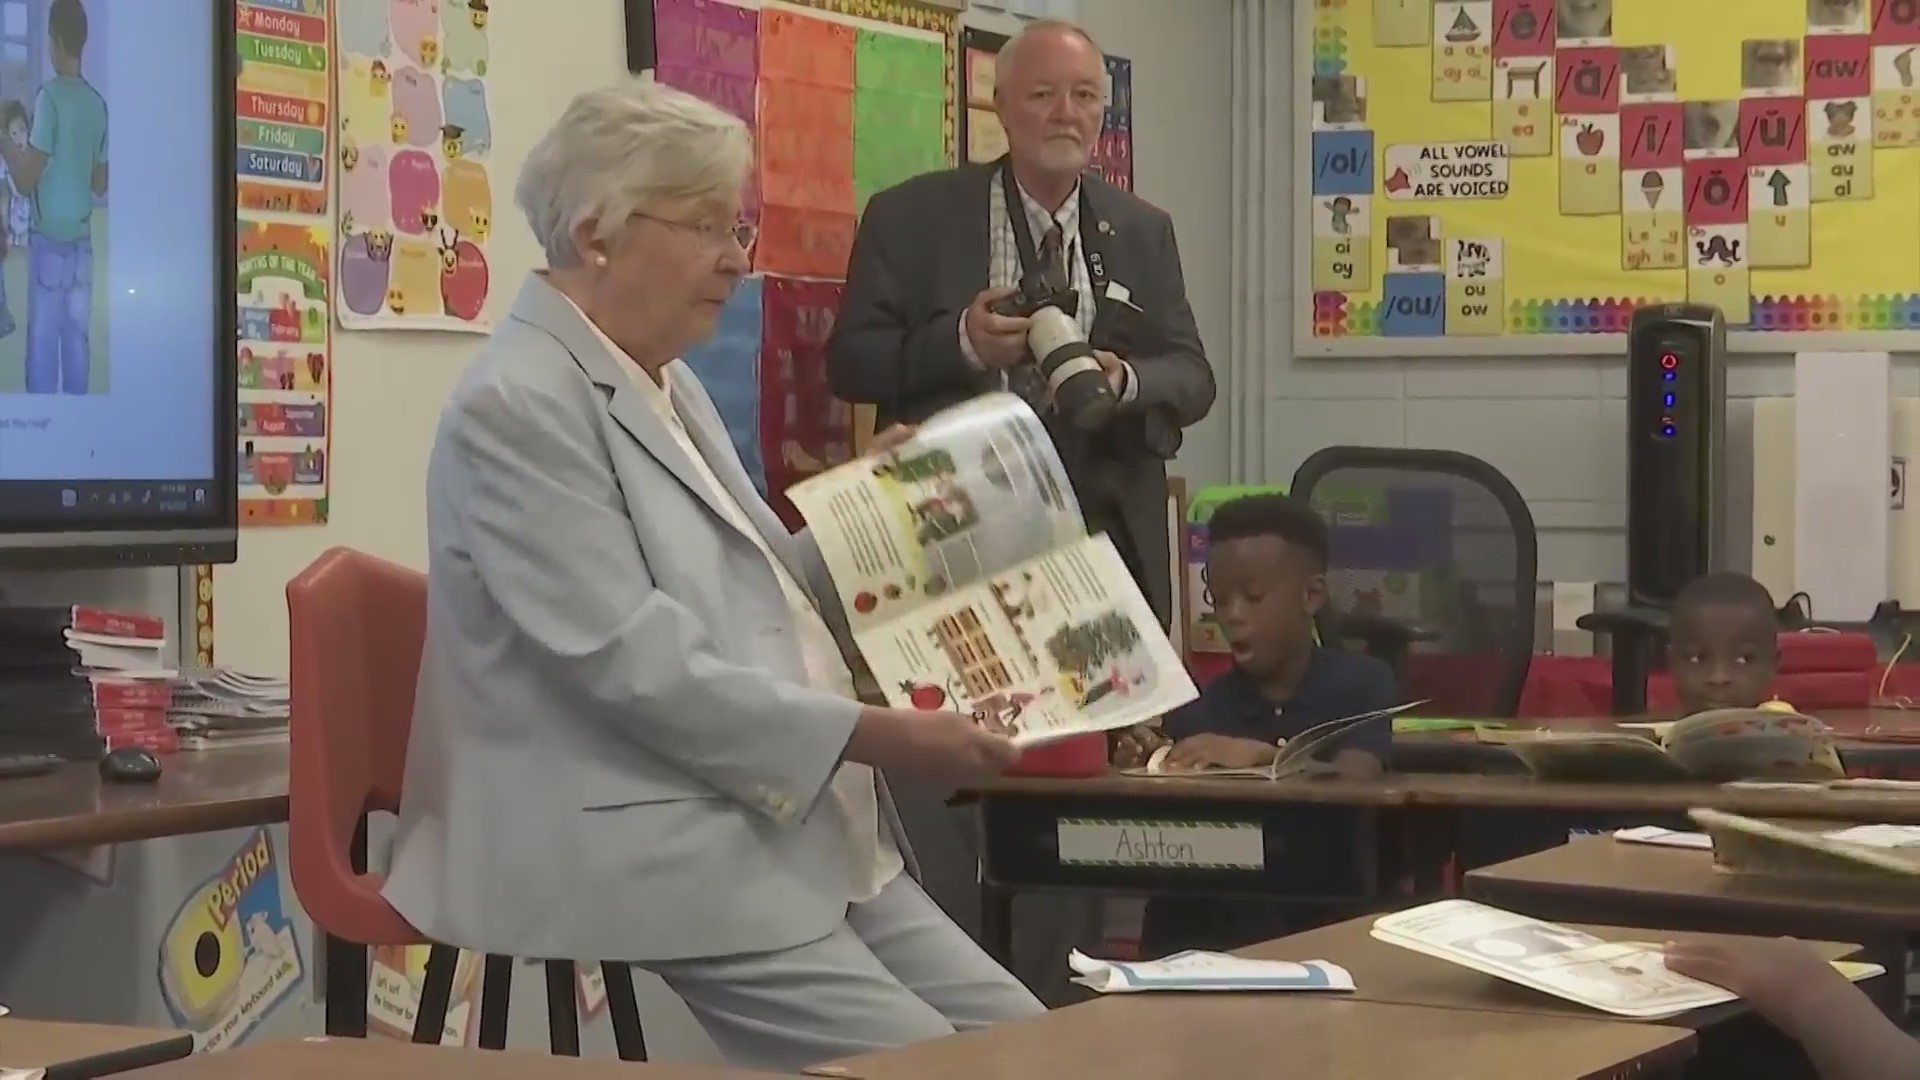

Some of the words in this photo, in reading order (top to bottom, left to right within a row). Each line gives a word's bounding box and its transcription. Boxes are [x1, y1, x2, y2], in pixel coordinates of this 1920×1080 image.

[254, 12, 301, 37] Monday
[254, 39, 302, 65] Tuesday
[251, 96, 304, 122] Thursday
[258, 126, 296, 148] Friday
[1512, 124, 1534, 137] ea
[1420, 147, 1450, 160] ALL
[1455, 144, 1508, 159] VOWEL
[1827, 144, 1856, 156] aw
[249, 153, 303, 178] Saturday
[1430, 163, 1493, 178] SOUNDS
[1585, 164, 1596, 175] a
[1831, 165, 1854, 177] au
[1415, 183, 1444, 197] ARE
[1450, 181, 1509, 196] VOICED
[1834, 180, 1851, 197] al
[1775, 215, 1787, 227] u
[1335, 239, 1351, 253] oi
[1332, 262, 1353, 280] oy
[1464, 286, 1486, 297] ou
[1385, 296, 1441, 319] /ou/
[1461, 305, 1488, 316] ow
[1115, 828, 1194, 860] Ashton
[207, 830, 271, 921] Period
